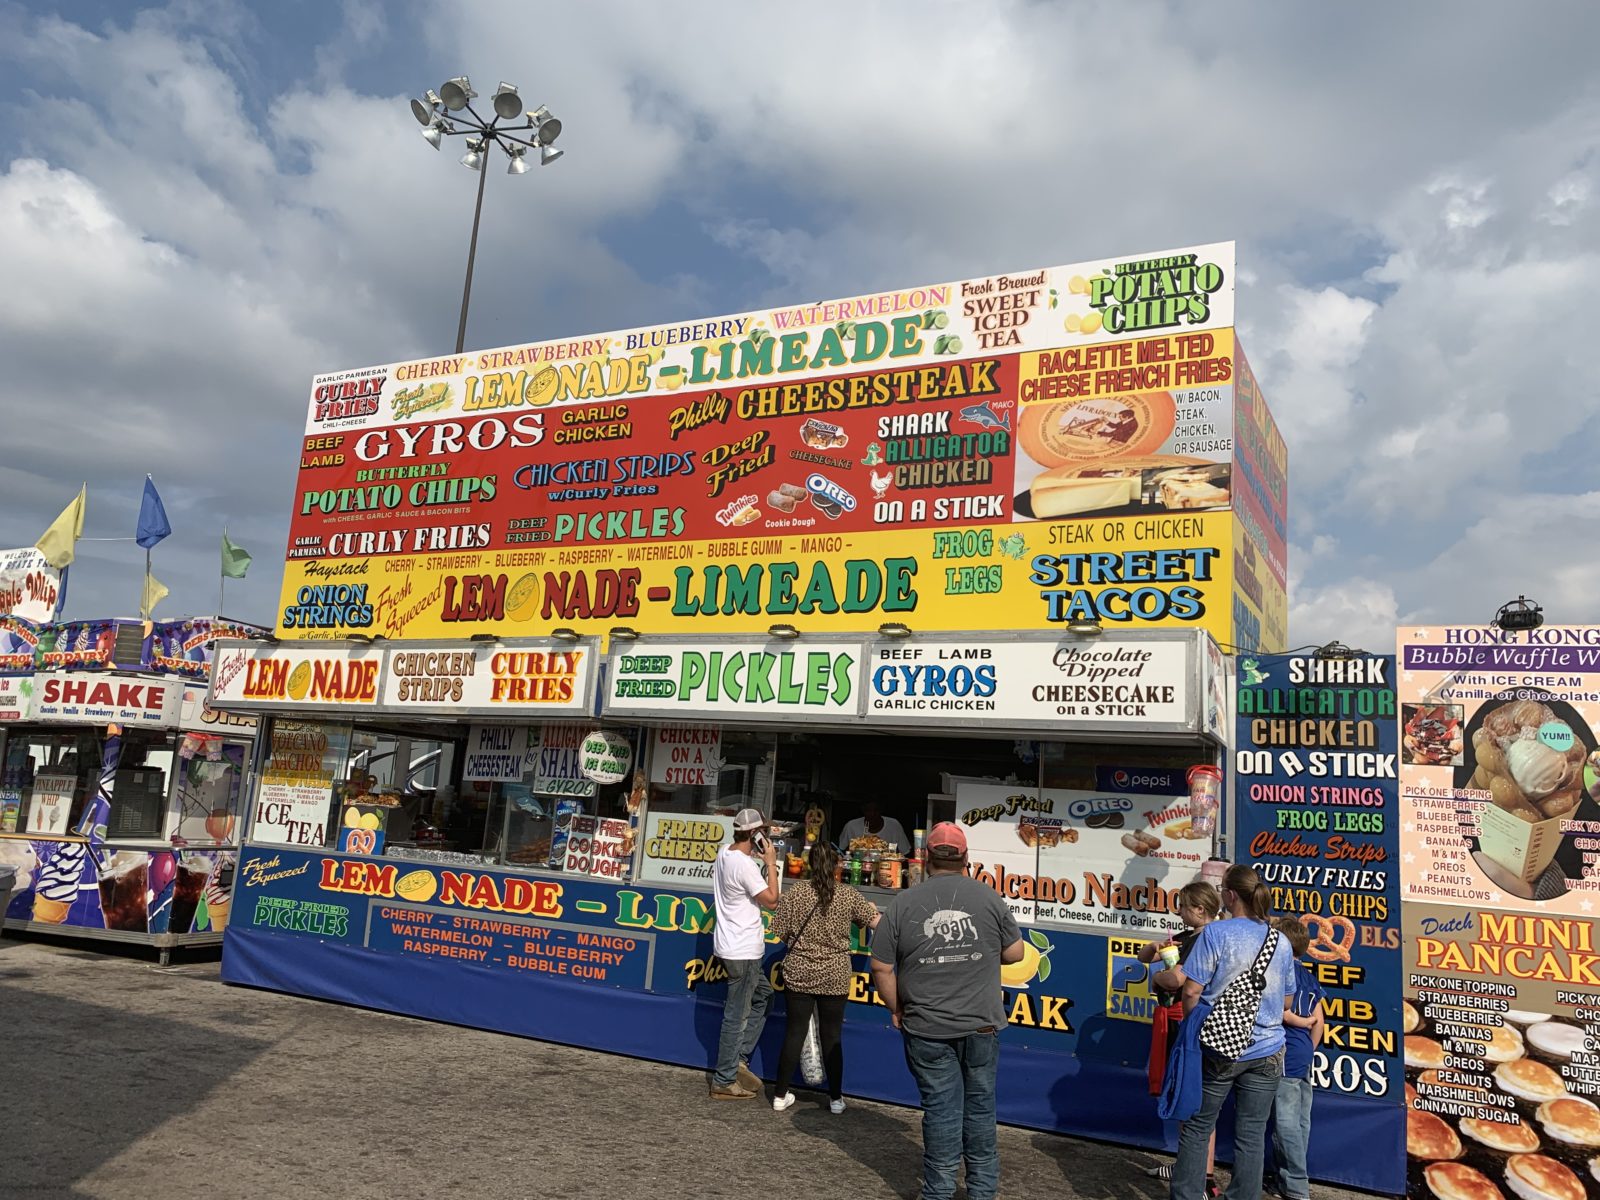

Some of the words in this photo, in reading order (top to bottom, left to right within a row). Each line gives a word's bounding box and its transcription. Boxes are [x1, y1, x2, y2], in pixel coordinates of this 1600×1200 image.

[1115, 254, 1198, 275] BUTTERFLY
[961, 280, 993, 297] Fresh
[997, 271, 1045, 290] Brewed
[1089, 262, 1224, 307] POTATO
[963, 290, 1040, 317] SWEET
[1101, 292, 1210, 333] CHIPS
[973, 309, 1029, 332] ICED
[396, 359, 463, 380] CHERRY
[480, 338, 608, 370] STRAWBERRY
[626, 317, 748, 350] BLUEBERRY
[774, 287, 947, 329] WATERMELON
[978, 329, 1021, 349] TEA
[1039, 342, 1132, 376] RACLETTE
[1137, 332, 1214, 362] MELTED
[316, 373, 344, 383] GARLIC
[345, 368, 387, 380] PARMESAN
[1020, 373, 1090, 401] CHEESE
[1095, 364, 1169, 395] FRENCH
[1174, 356, 1232, 385] FRIES
[314, 376, 386, 403] CURLY
[669, 391, 731, 441] Philly
[736, 360, 1000, 420] CHEESESTEAK
[314, 398, 379, 422] FRIES
[562, 404, 628, 425] GARLIC
[992, 400, 1014, 409] MAKO
[322, 418, 367, 429] CHILI-CHEESE
[554, 423, 632, 444] CHICKEN
[878, 411, 951, 438] SHARK
[306, 436, 344, 451] BEEF
[354, 413, 547, 462] GYROS
[702, 430, 770, 466] Deep
[885, 430, 1010, 463] ALLIGATOR
[300, 453, 345, 468] LAMB
[513, 458, 608, 489] CHICKEN
[612, 451, 696, 484] STRIPS
[706, 445, 775, 498] Fried
[789, 450, 853, 470] CHEESECAKE
[356, 463, 451, 482] BUTTERFLY
[894, 458, 992, 488] CHICKEN
[301, 483, 402, 516] POTATO
[408, 475, 497, 506] CHIPS
[806, 473, 857, 511] OREO
[366, 511, 392, 520] GARLIC
[395, 509, 420, 518] SAUCE
[427, 507, 452, 516] BACON
[454, 506, 470, 515] BITS
[717, 495, 758, 525] Twinkies
[874, 500, 904, 523] ON
[910, 499, 928, 521] A
[934, 494, 1005, 520] STICK
[554, 506, 687, 542] PICKLES
[1049, 524, 1094, 544] STEAK
[1103, 523, 1124, 541] OR
[1134, 518, 1203, 540] CHICKEN
[329, 529, 408, 557] CURLY
[413, 523, 492, 553] FRIES
[933, 529, 993, 558] FROG
[385, 557, 417, 572] CHERRY
[426, 555, 482, 571] STRAWBERRY
[495, 552, 547, 567] BLUEBERRY
[558, 549, 614, 565] RASPBERRY
[627, 545, 693, 562] WATERMELON
[708, 542, 748, 558] BUBBLE
[750, 540, 783, 555] GUMM
[801, 537, 842, 553] MANGO
[1029, 547, 1219, 586] STREET
[304, 558, 370, 580] Haystack
[945, 565, 1002, 595] LEGS
[296, 583, 369, 607] ONION
[1040, 586, 1206, 622] TACOS
[283, 604, 374, 629] STRINGS
[1445, 629, 1519, 645] HONG
[392, 652, 477, 677] CHICKEN
[490, 651, 582, 677] CURLY
[619, 655, 673, 674] DEEP
[1052, 647, 1153, 667] Chocolate
[1410, 648, 1486, 665] Bubble
[1492, 648, 1570, 670] Waffle
[678, 651, 855, 706] PICKLES
[872, 664, 998, 697] GYROS
[1060, 661, 1145, 682] Dipped
[1289, 657, 1388, 686] SHARK
[1453, 675, 1487, 686] With
[1491, 676, 1517, 686] ICE
[1522, 676, 1582, 687] CREAM
[43, 679, 166, 710] SHAKE
[398, 677, 464, 703] STRIPS
[490, 677, 575, 704] FRIES
[615, 679, 677, 698] FRIED
[1032, 684, 1175, 704] CHEESECAKE
[63, 707, 79, 715] Vanilla
[84, 707, 115, 719] Strawberry
[120, 709, 137, 720] Cherry
[143, 711, 162, 720] Banana
[1237, 688, 1396, 718] ALLIGATOR
[479, 727, 515, 751] PHILLY
[1251, 718, 1379, 748] CHICKEN
[1542, 731, 1571, 742] YUM!!
[467, 753, 522, 779] CHEESESTEAK
[584, 757, 599, 770] ICE
[35, 778, 73, 792] PINEAPPLE
[546, 779, 594, 796] GYROS
[1131, 774, 1171, 788] pepsi
[41, 793, 60, 807] WHIP
[1250, 784, 1306, 804] ONION
[1310, 787, 1384, 806] STRINGS
[1412, 799, 1486, 812] STRAWBERRIES
[256, 801, 292, 825] ICE
[1069, 798, 1133, 818] OREO
[1416, 812, 1481, 824] BLUEBERRIES
[285, 820, 324, 846] TEA
[1276, 809, 1328, 831] FROG
[1333, 812, 1384, 833] LEGS
[1416, 824, 1482, 837] RASPBERRIES
[1250, 831, 1319, 858] Chicken
[1324, 836, 1387, 866] Strips
[1425, 837, 1473, 849] BANANAS
[1149, 850, 1175, 860] Cookie
[1177, 851, 1201, 862] Dough
[1409, 883, 1491, 901] MARSHMELLOWS
[253, 904, 349, 938] PICKLES
[381, 908, 434, 925] CHERRY
[452, 916, 551, 940] STRAWBERRY
[577, 932, 636, 952] MANGO
[1058, 908, 1095, 923] Cheese,
[1097, 910, 1118, 925] Chili
[1130, 914, 1164, 930] Garlic
[1421, 911, 1475, 936] Dutch
[1478, 911, 1595, 953] MINI
[391, 923, 493, 948] WATERMELON
[524, 941, 624, 966] BLUEBERRY
[403, 940, 487, 961] RASPBERRY
[507, 955, 567, 975] BUBBLE
[571, 964, 606, 980] GUM
[1410, 974, 1437, 989] PICK
[1438, 978, 1463, 991] ONE
[1464, 980, 1516, 997] TOPPING
[1418, 991, 1509, 1012] STRAWBERRIES
[1424, 1007, 1504, 1027] BLUEBERRIES
[1435, 1024, 1492, 1041] BANANAS
[1444, 1056, 1485, 1072] OREOS
[1437, 1070, 1492, 1088] PEANUTS
[1416, 1083, 1516, 1108] MARSHMELLOWS
[1413, 1098, 1478, 1118] CINNAMON
[1477, 1105, 1521, 1126] SUGAR
